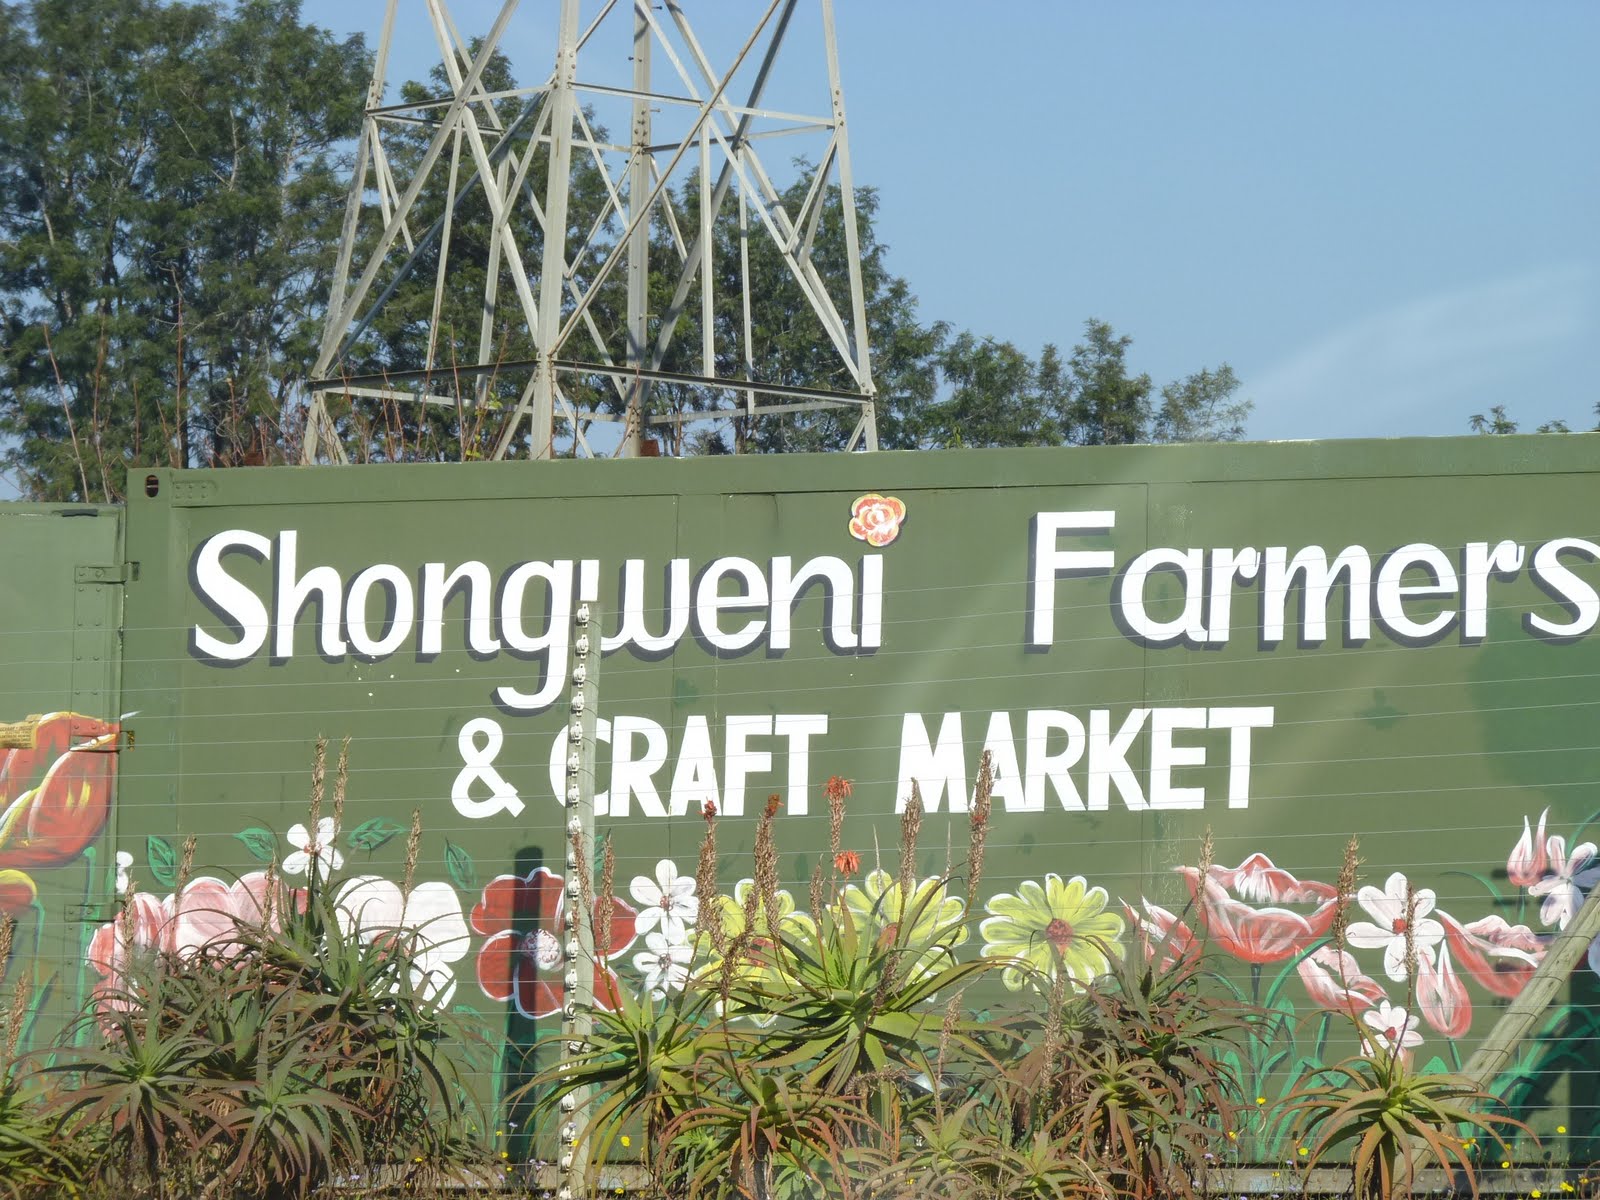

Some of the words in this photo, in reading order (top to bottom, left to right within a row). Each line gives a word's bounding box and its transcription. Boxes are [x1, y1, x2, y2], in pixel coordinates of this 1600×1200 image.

[195, 493, 905, 709] Shongweni
[1032, 511, 1600, 645] Farmers
[451, 717, 526, 818] &
[549, 713, 828, 818] CRAFT
[895, 706, 1274, 814] MARKET
